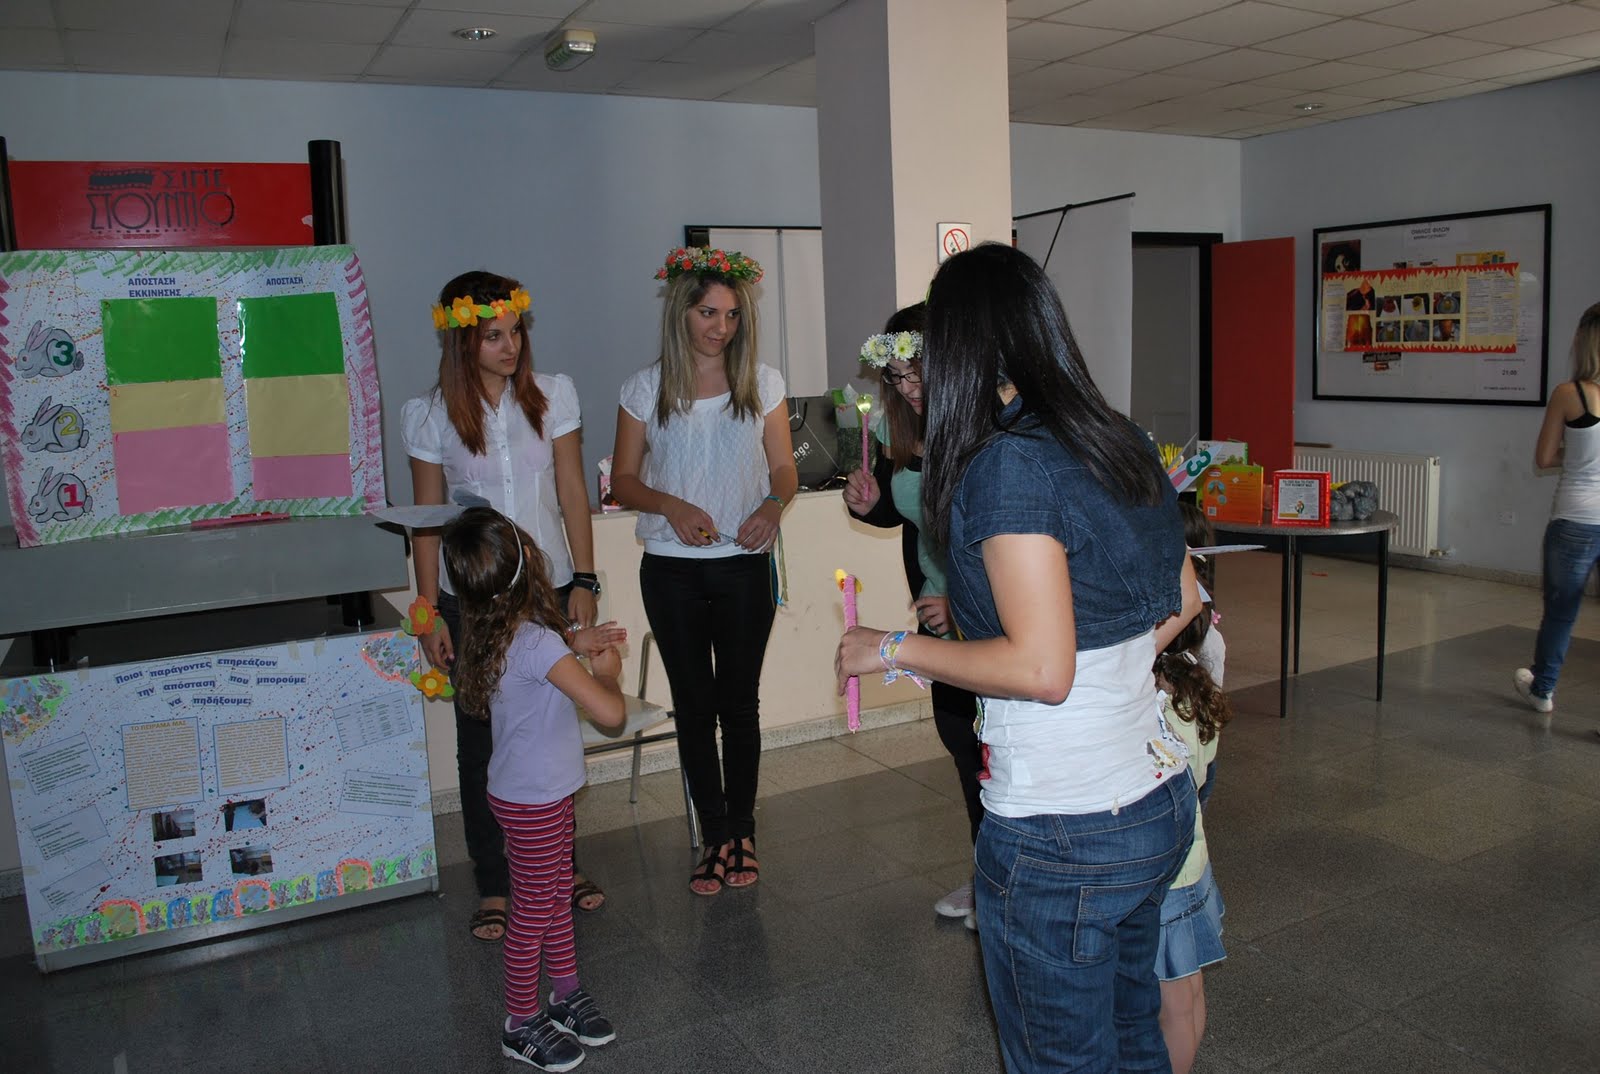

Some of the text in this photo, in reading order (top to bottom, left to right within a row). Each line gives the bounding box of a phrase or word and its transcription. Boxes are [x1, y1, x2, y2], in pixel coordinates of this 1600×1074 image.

[128, 276, 177, 287] ΑΠΟΣΤΑΣΗ
[266, 276, 304, 286] ΑΠΟΣΤΑΣΗ
[128, 288, 182, 298] ΕΚΚΙΝΗΣΗΣ
[52, 340, 75, 367] 3
[58, 412, 80, 436] 2
[792, 441, 810, 459] ngo
[63, 484, 83, 507] 1
[115, 657, 278, 685] Ποιοι παράγοντες επηρεάζουν
[137, 674, 306, 698] την απόσταση που μπορούμε
[168, 695, 252, 707] να πηδήξουμε;
